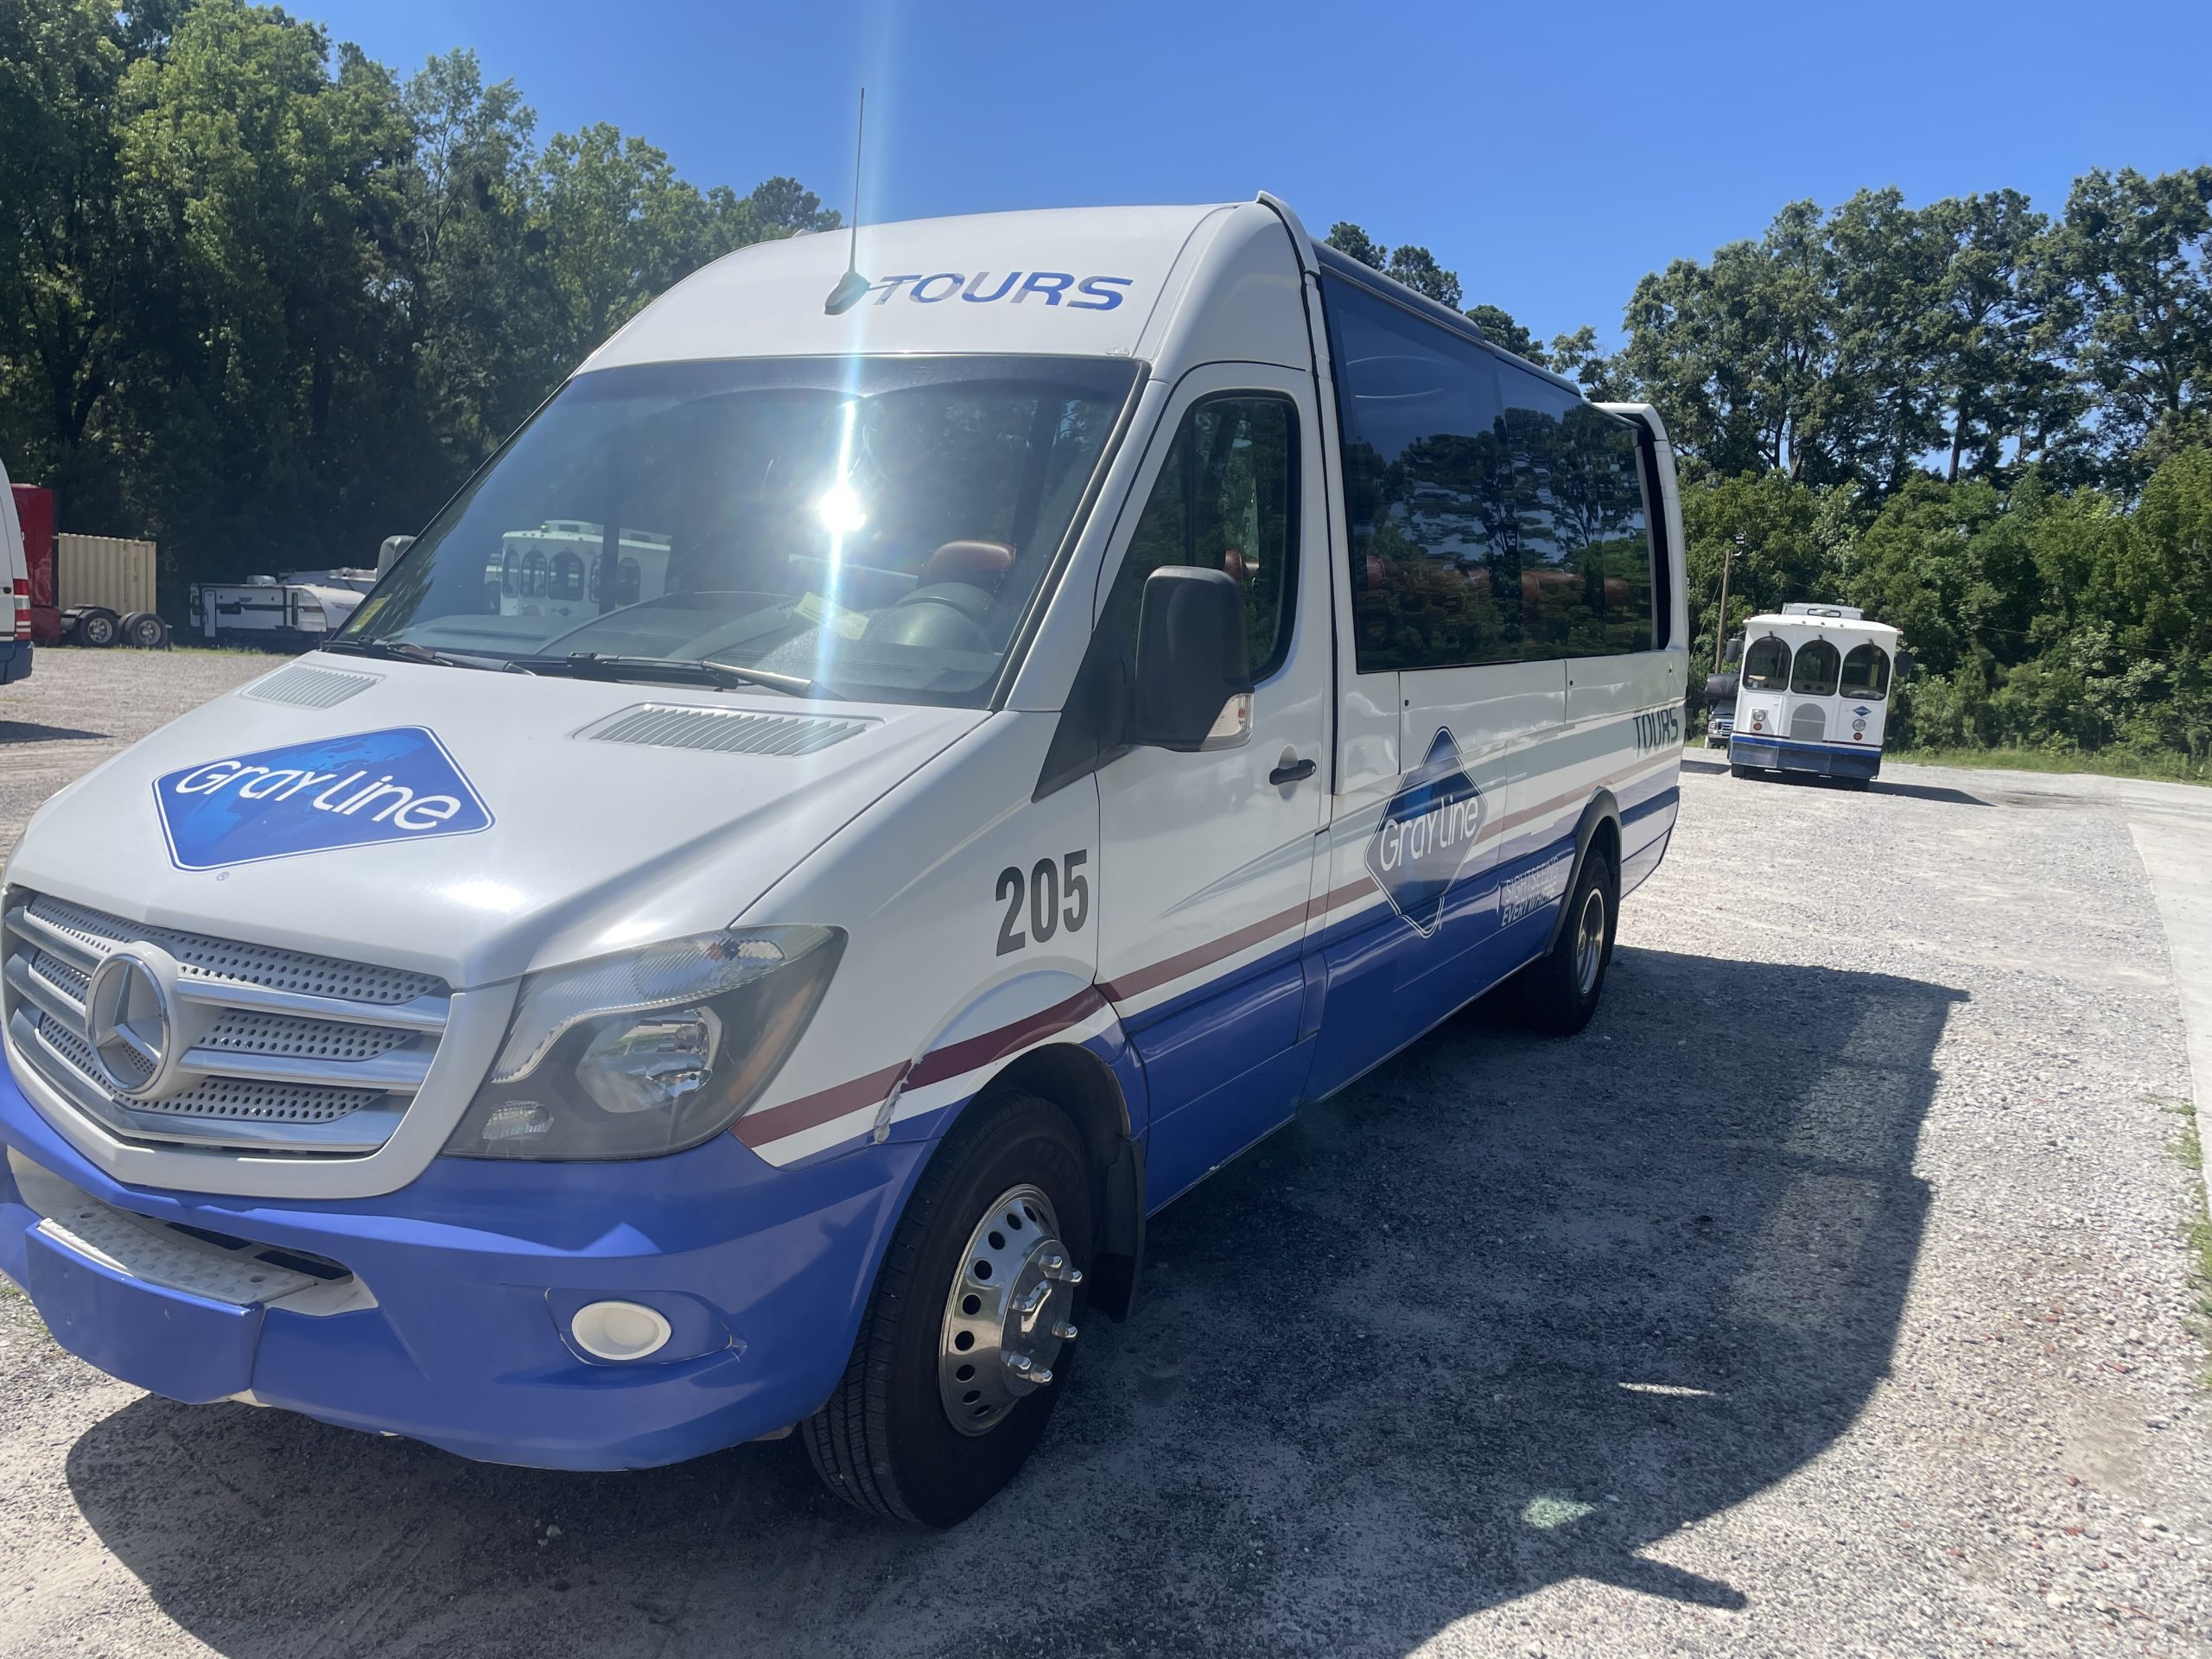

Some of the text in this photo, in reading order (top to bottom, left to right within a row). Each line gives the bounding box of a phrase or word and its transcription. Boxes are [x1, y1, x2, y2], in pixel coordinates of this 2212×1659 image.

[873, 270, 1134, 311] TOURS
[1632, 707, 1679, 758] TOURS
[995, 849, 1089, 957] 205
[1501, 880, 1557, 927] EVERYWHERE
[1505, 855, 1559, 904] SIGHTSEEING
